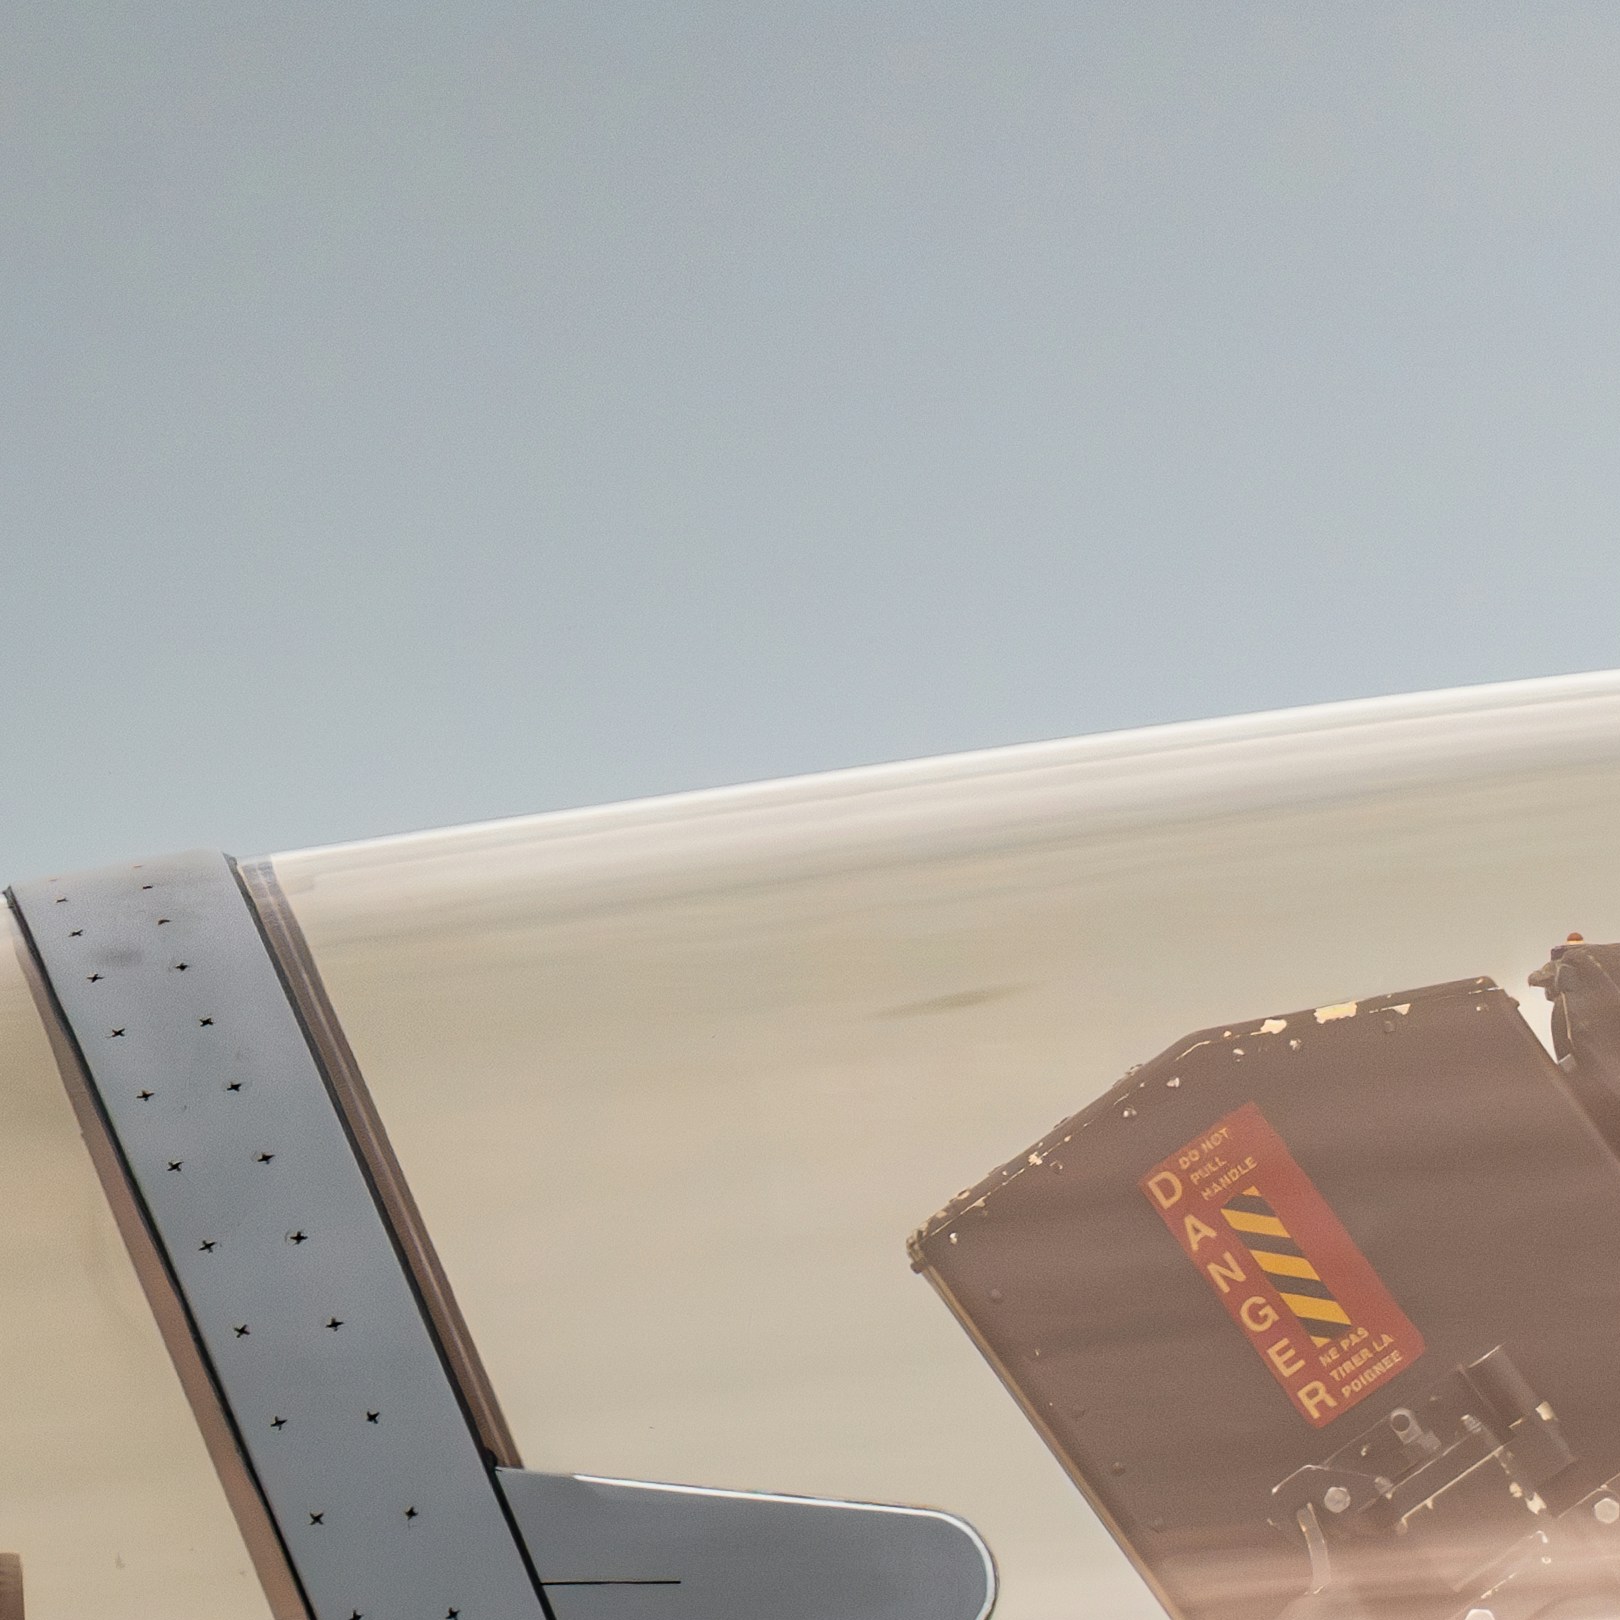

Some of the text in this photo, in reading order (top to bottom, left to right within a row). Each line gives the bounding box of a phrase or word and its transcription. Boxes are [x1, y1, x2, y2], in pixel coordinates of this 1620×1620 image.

[1179, 1127, 1229, 1170] DO NOT
[1190, 1156, 1227, 1185] PULL
[1201, 1156, 1257, 1201] HANDLE
[1148, 1171, 1338, 1419] DANGER
[1319, 1327, 1369, 1367] NE PAS
[1329, 1334, 1395, 1381] TIRER LA
[1341, 1350, 1402, 1399] POIGNEE
